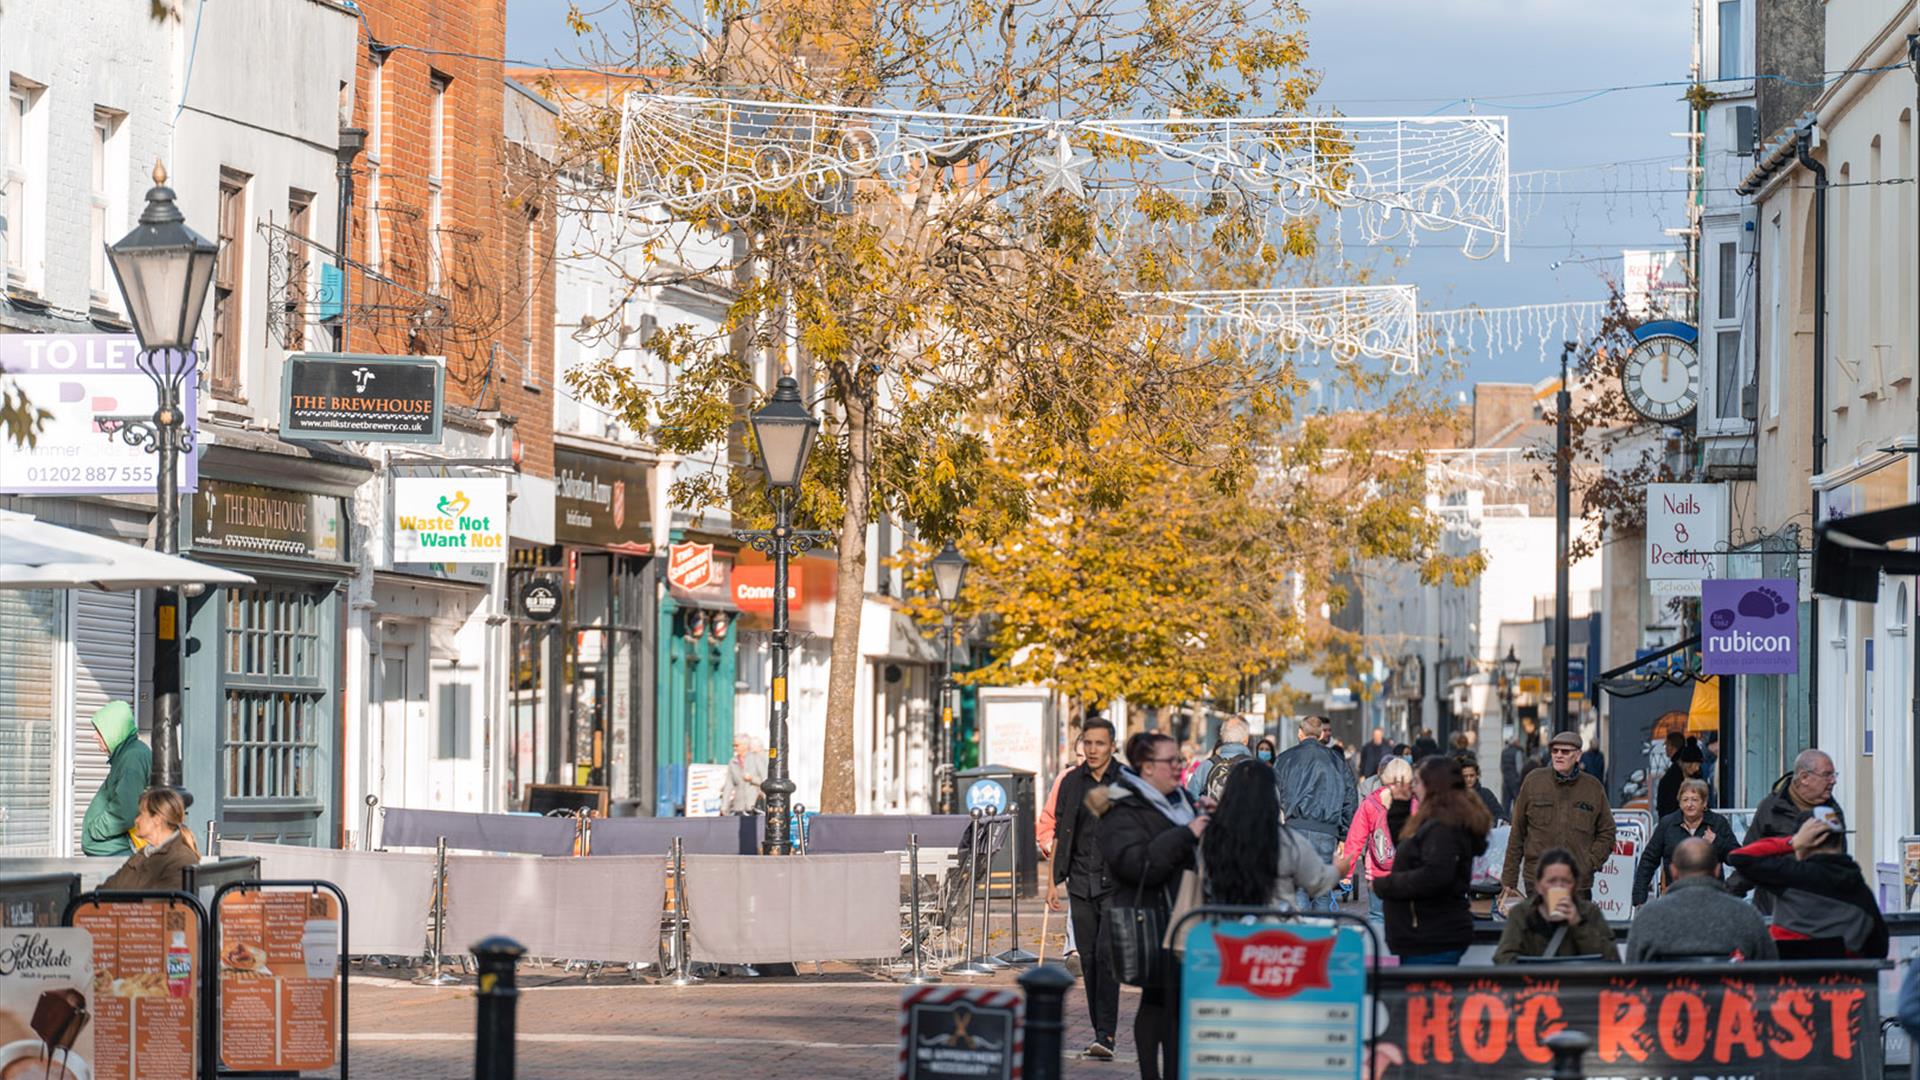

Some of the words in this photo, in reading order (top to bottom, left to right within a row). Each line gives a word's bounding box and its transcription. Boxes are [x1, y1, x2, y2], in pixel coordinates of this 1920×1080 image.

[23, 339, 77, 369] TO
[293, 395, 326, 410] THE
[331, 396, 432, 413] BREWHOUSE
[300, 419, 422, 432] www.milkstreetbrewery.co.uk
[27, 466, 81, 482] 01202
[85, 466, 117, 482] 887
[122, 466, 153, 482] 555
[224, 493, 244, 525] THE
[247, 497, 307, 533] BREWHOUSE
[1663, 492, 1701, 515] Nails
[399, 516, 454, 531] Waste
[459, 516, 490, 531] Not
[420, 533, 467, 547] Want
[471, 533, 502, 548] Not
[1651, 543, 1710, 571] Beauty
[1709, 630, 1791, 652] rubicon
[1601, 859, 1620, 875] ails
[13, 932, 49, 960] Hot
[1240, 944, 1308, 966] PRICE
[1249, 965, 1299, 986] LIST
[1406, 978, 1568, 1064] HOG
[1598, 974, 1867, 1063] ROAST
